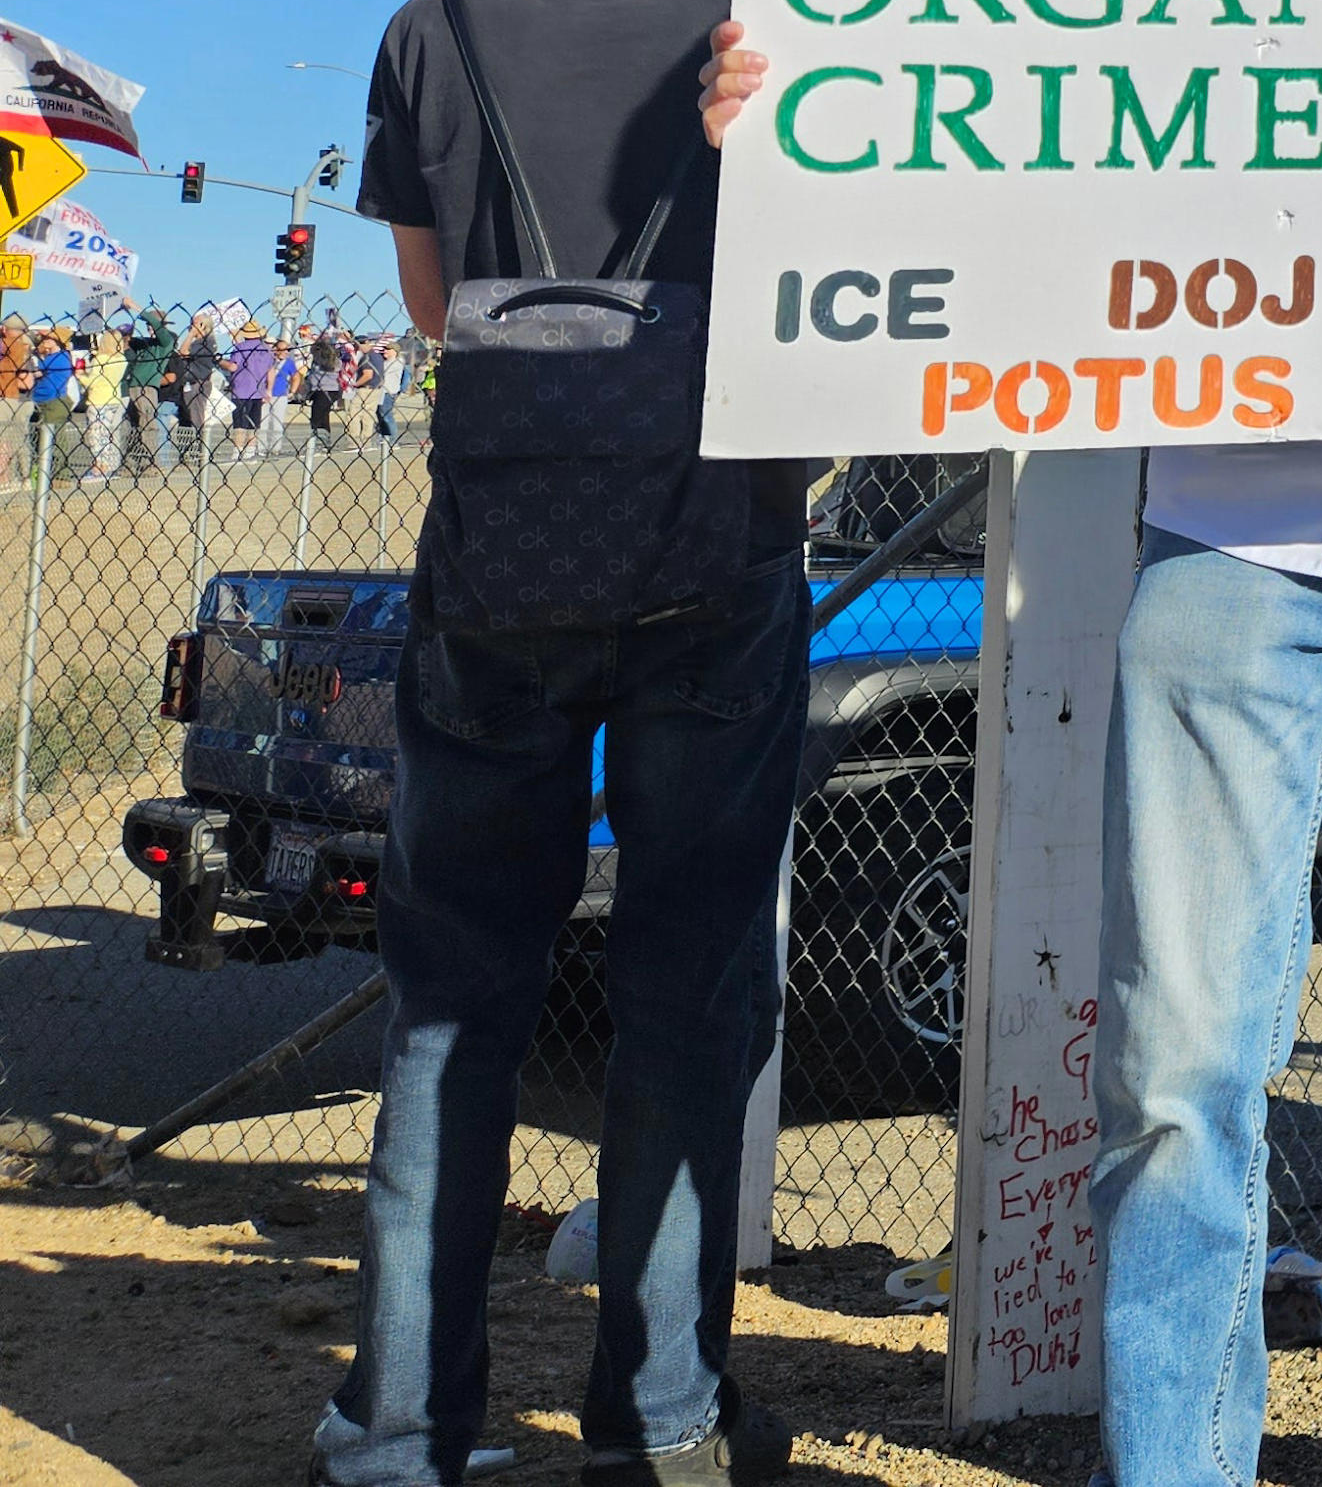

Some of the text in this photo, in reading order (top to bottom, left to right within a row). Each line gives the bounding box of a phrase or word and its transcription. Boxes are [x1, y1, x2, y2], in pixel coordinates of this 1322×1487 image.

[6, 94, 75, 114] CALIFORNIA
[774, 255, 1316, 344] ICE DOJ
[922, 355, 1295, 437] POTUS
[270, 651, 341, 703] Jeep
